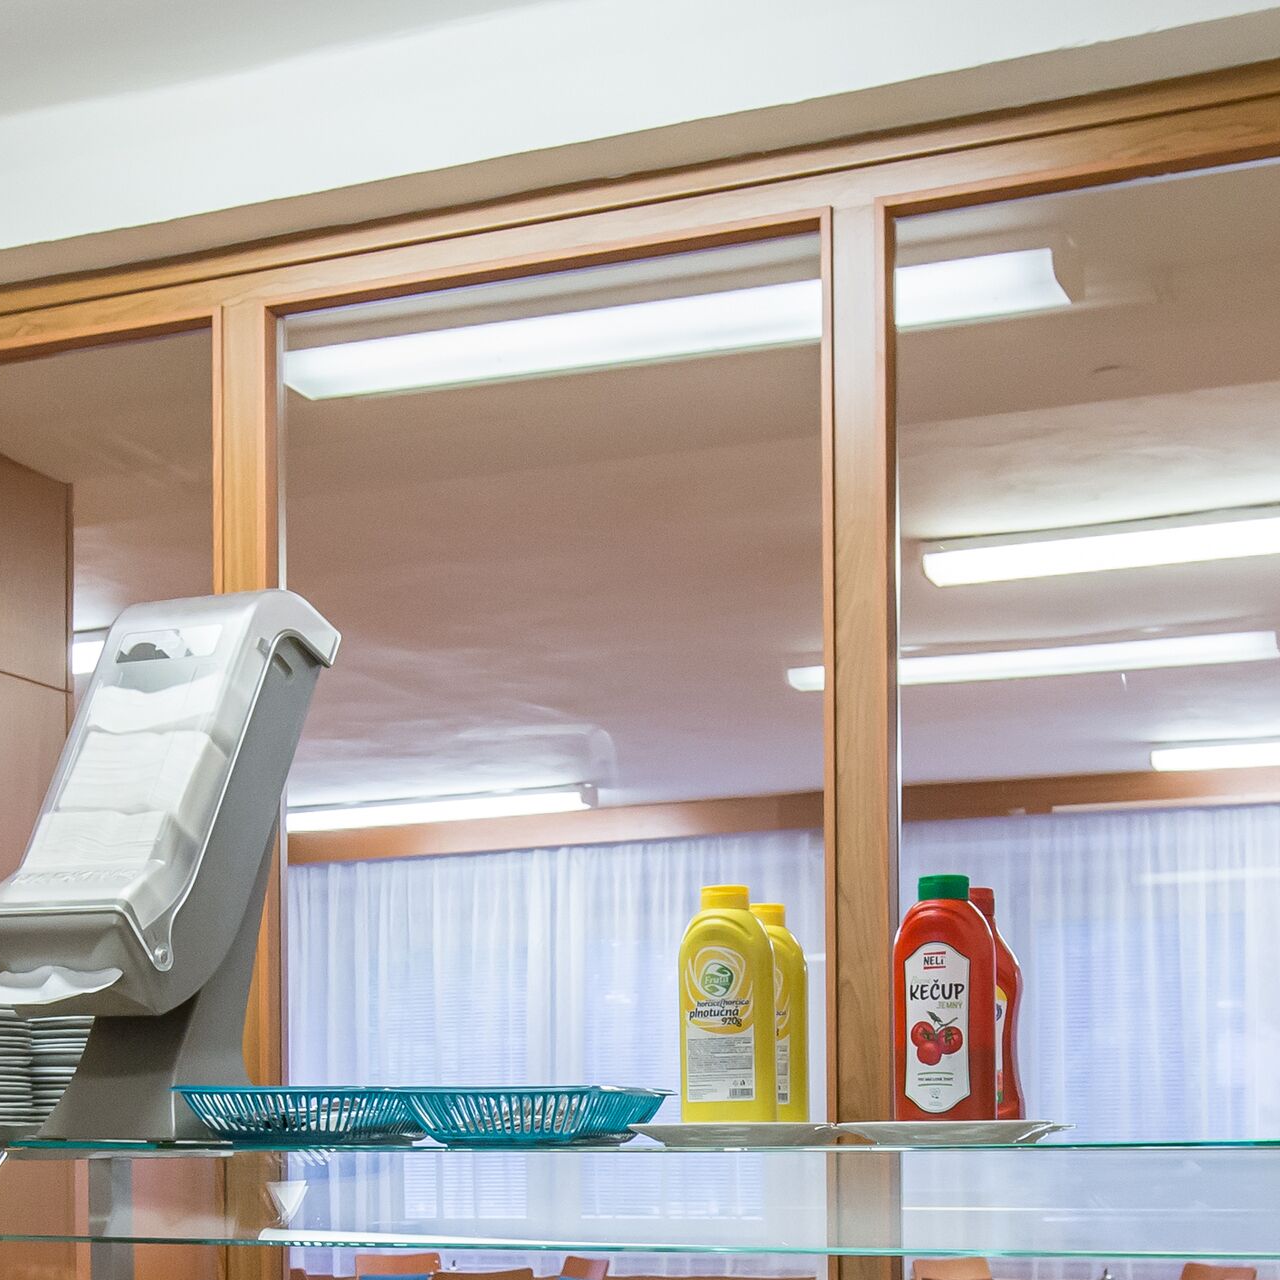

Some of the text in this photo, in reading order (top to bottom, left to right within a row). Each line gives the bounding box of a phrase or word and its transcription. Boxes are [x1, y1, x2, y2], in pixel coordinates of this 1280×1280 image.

[910, 979, 965, 1001] KEČUP
[689, 1006, 739, 1021] plnotučná
[721, 1016, 743, 1027] 920g
